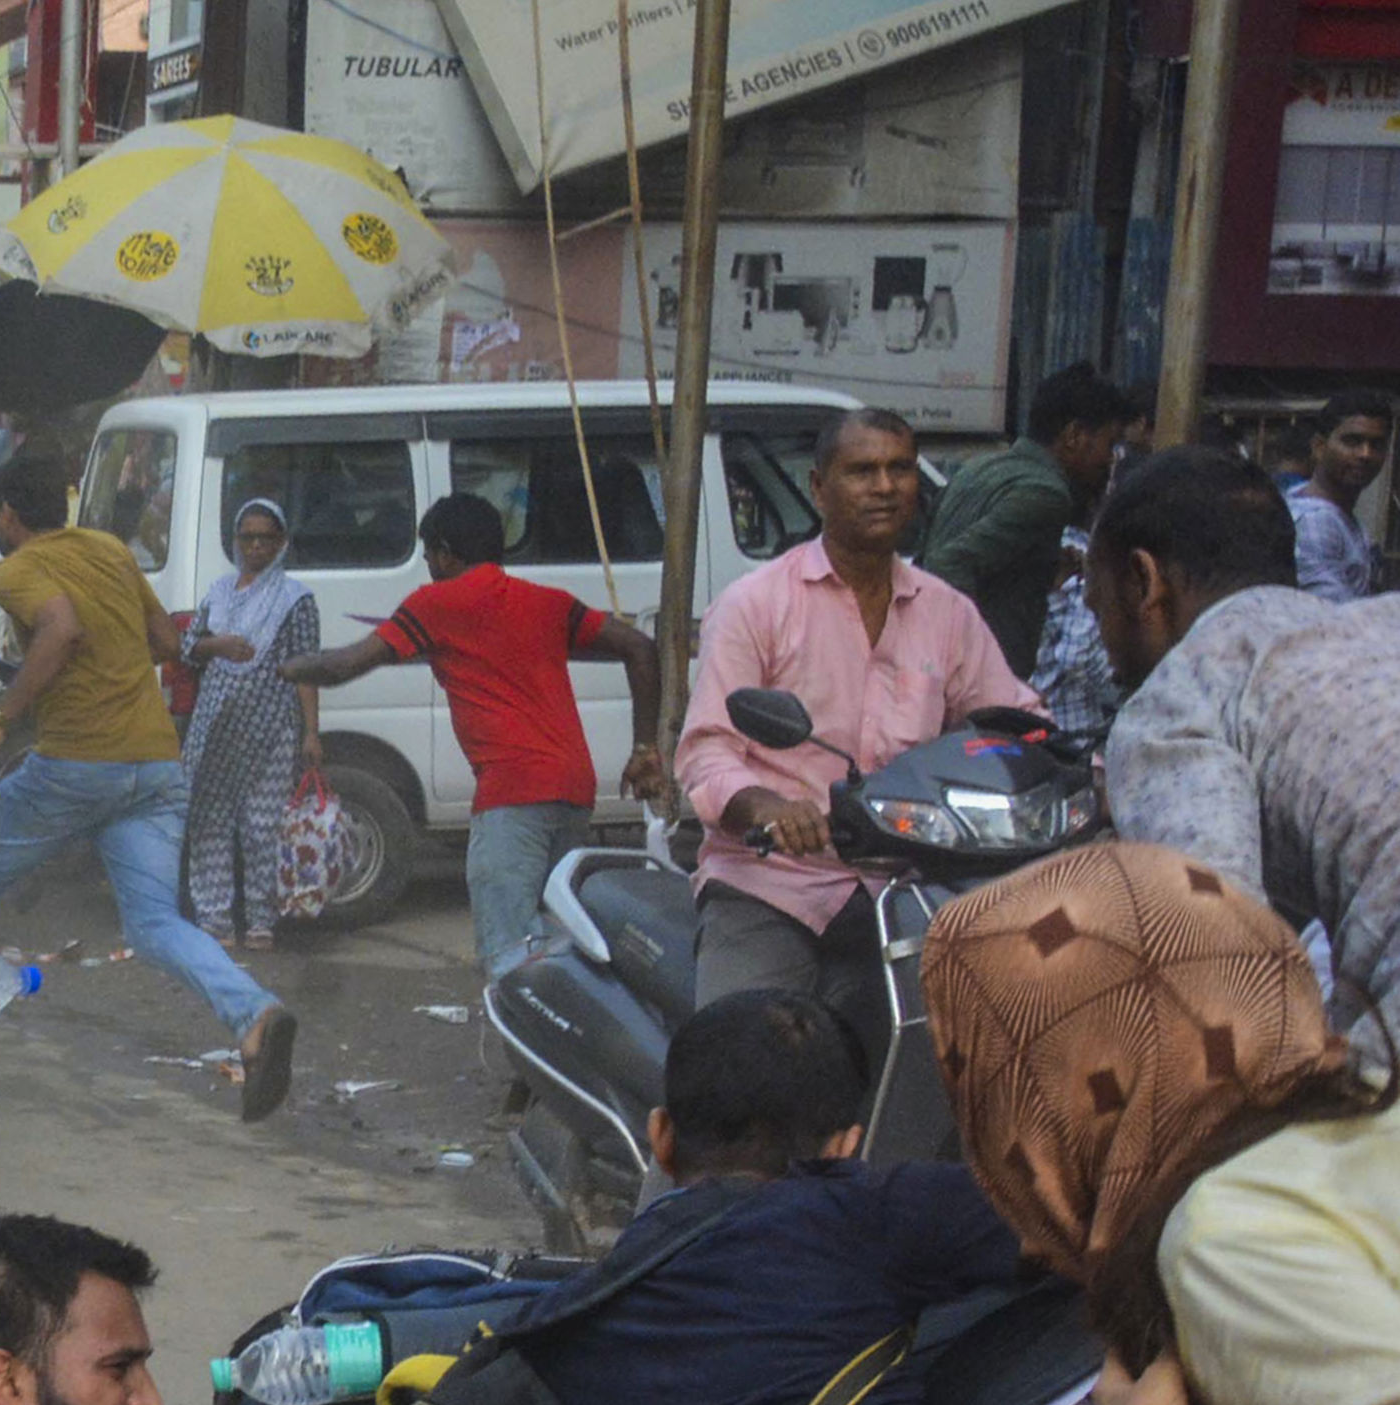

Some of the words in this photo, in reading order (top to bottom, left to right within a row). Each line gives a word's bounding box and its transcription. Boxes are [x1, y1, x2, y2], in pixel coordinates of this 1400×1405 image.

[554, 26, 603, 50] Water
[607, 4, 674, 36] Prifiers
[344, 55, 463, 78] TUBULAR
[742, 47, 842, 97] AGENCIES
